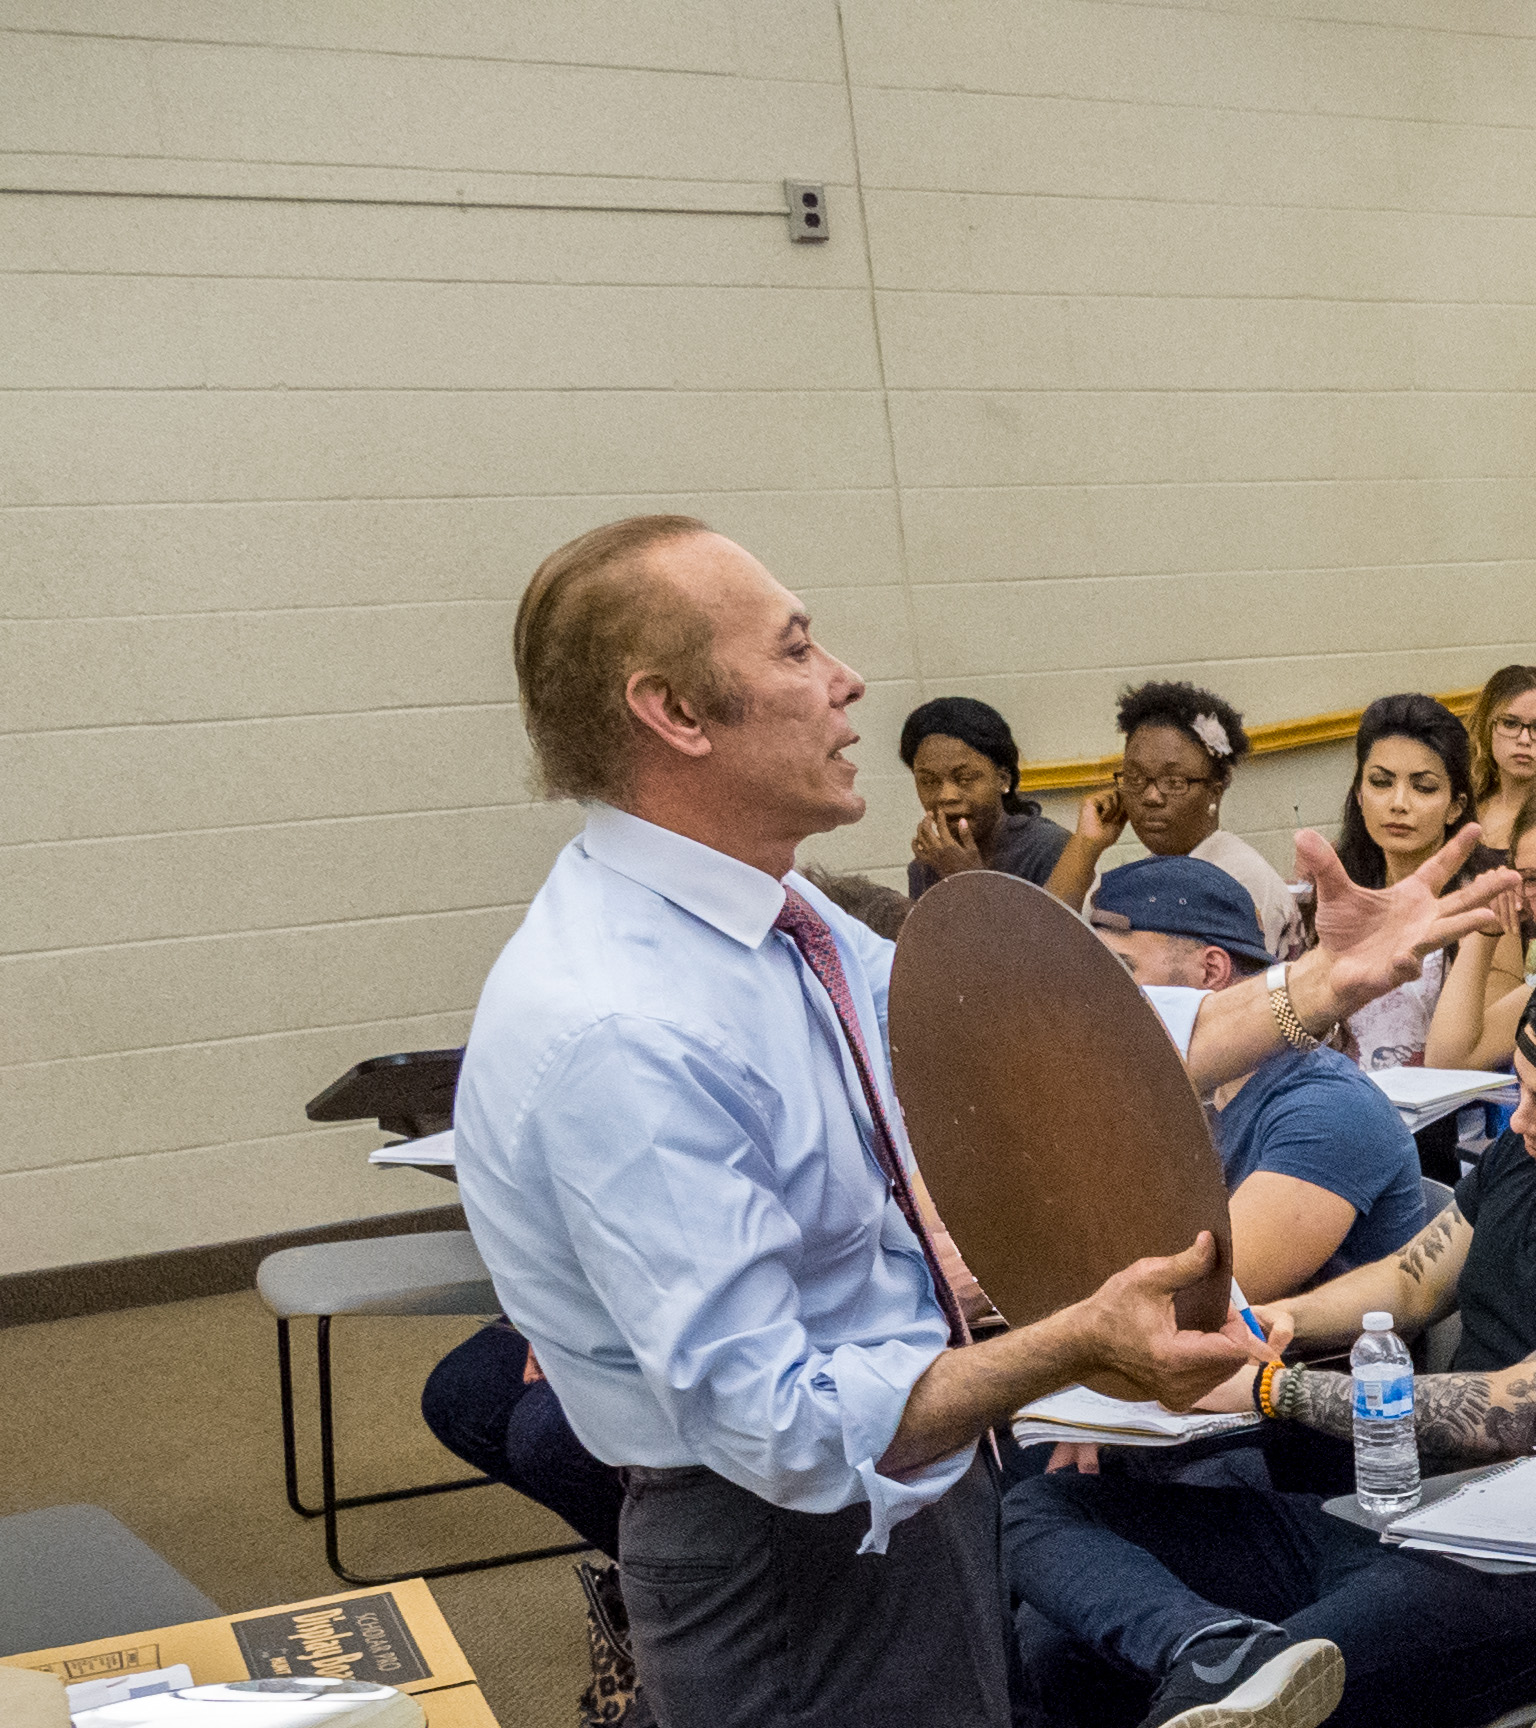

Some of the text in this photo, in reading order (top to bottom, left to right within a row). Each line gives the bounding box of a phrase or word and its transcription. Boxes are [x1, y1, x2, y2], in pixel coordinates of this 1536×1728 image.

[288, 1607, 354, 1661] Display
[355, 1612, 402, 1672] SCHOLAR PRO
